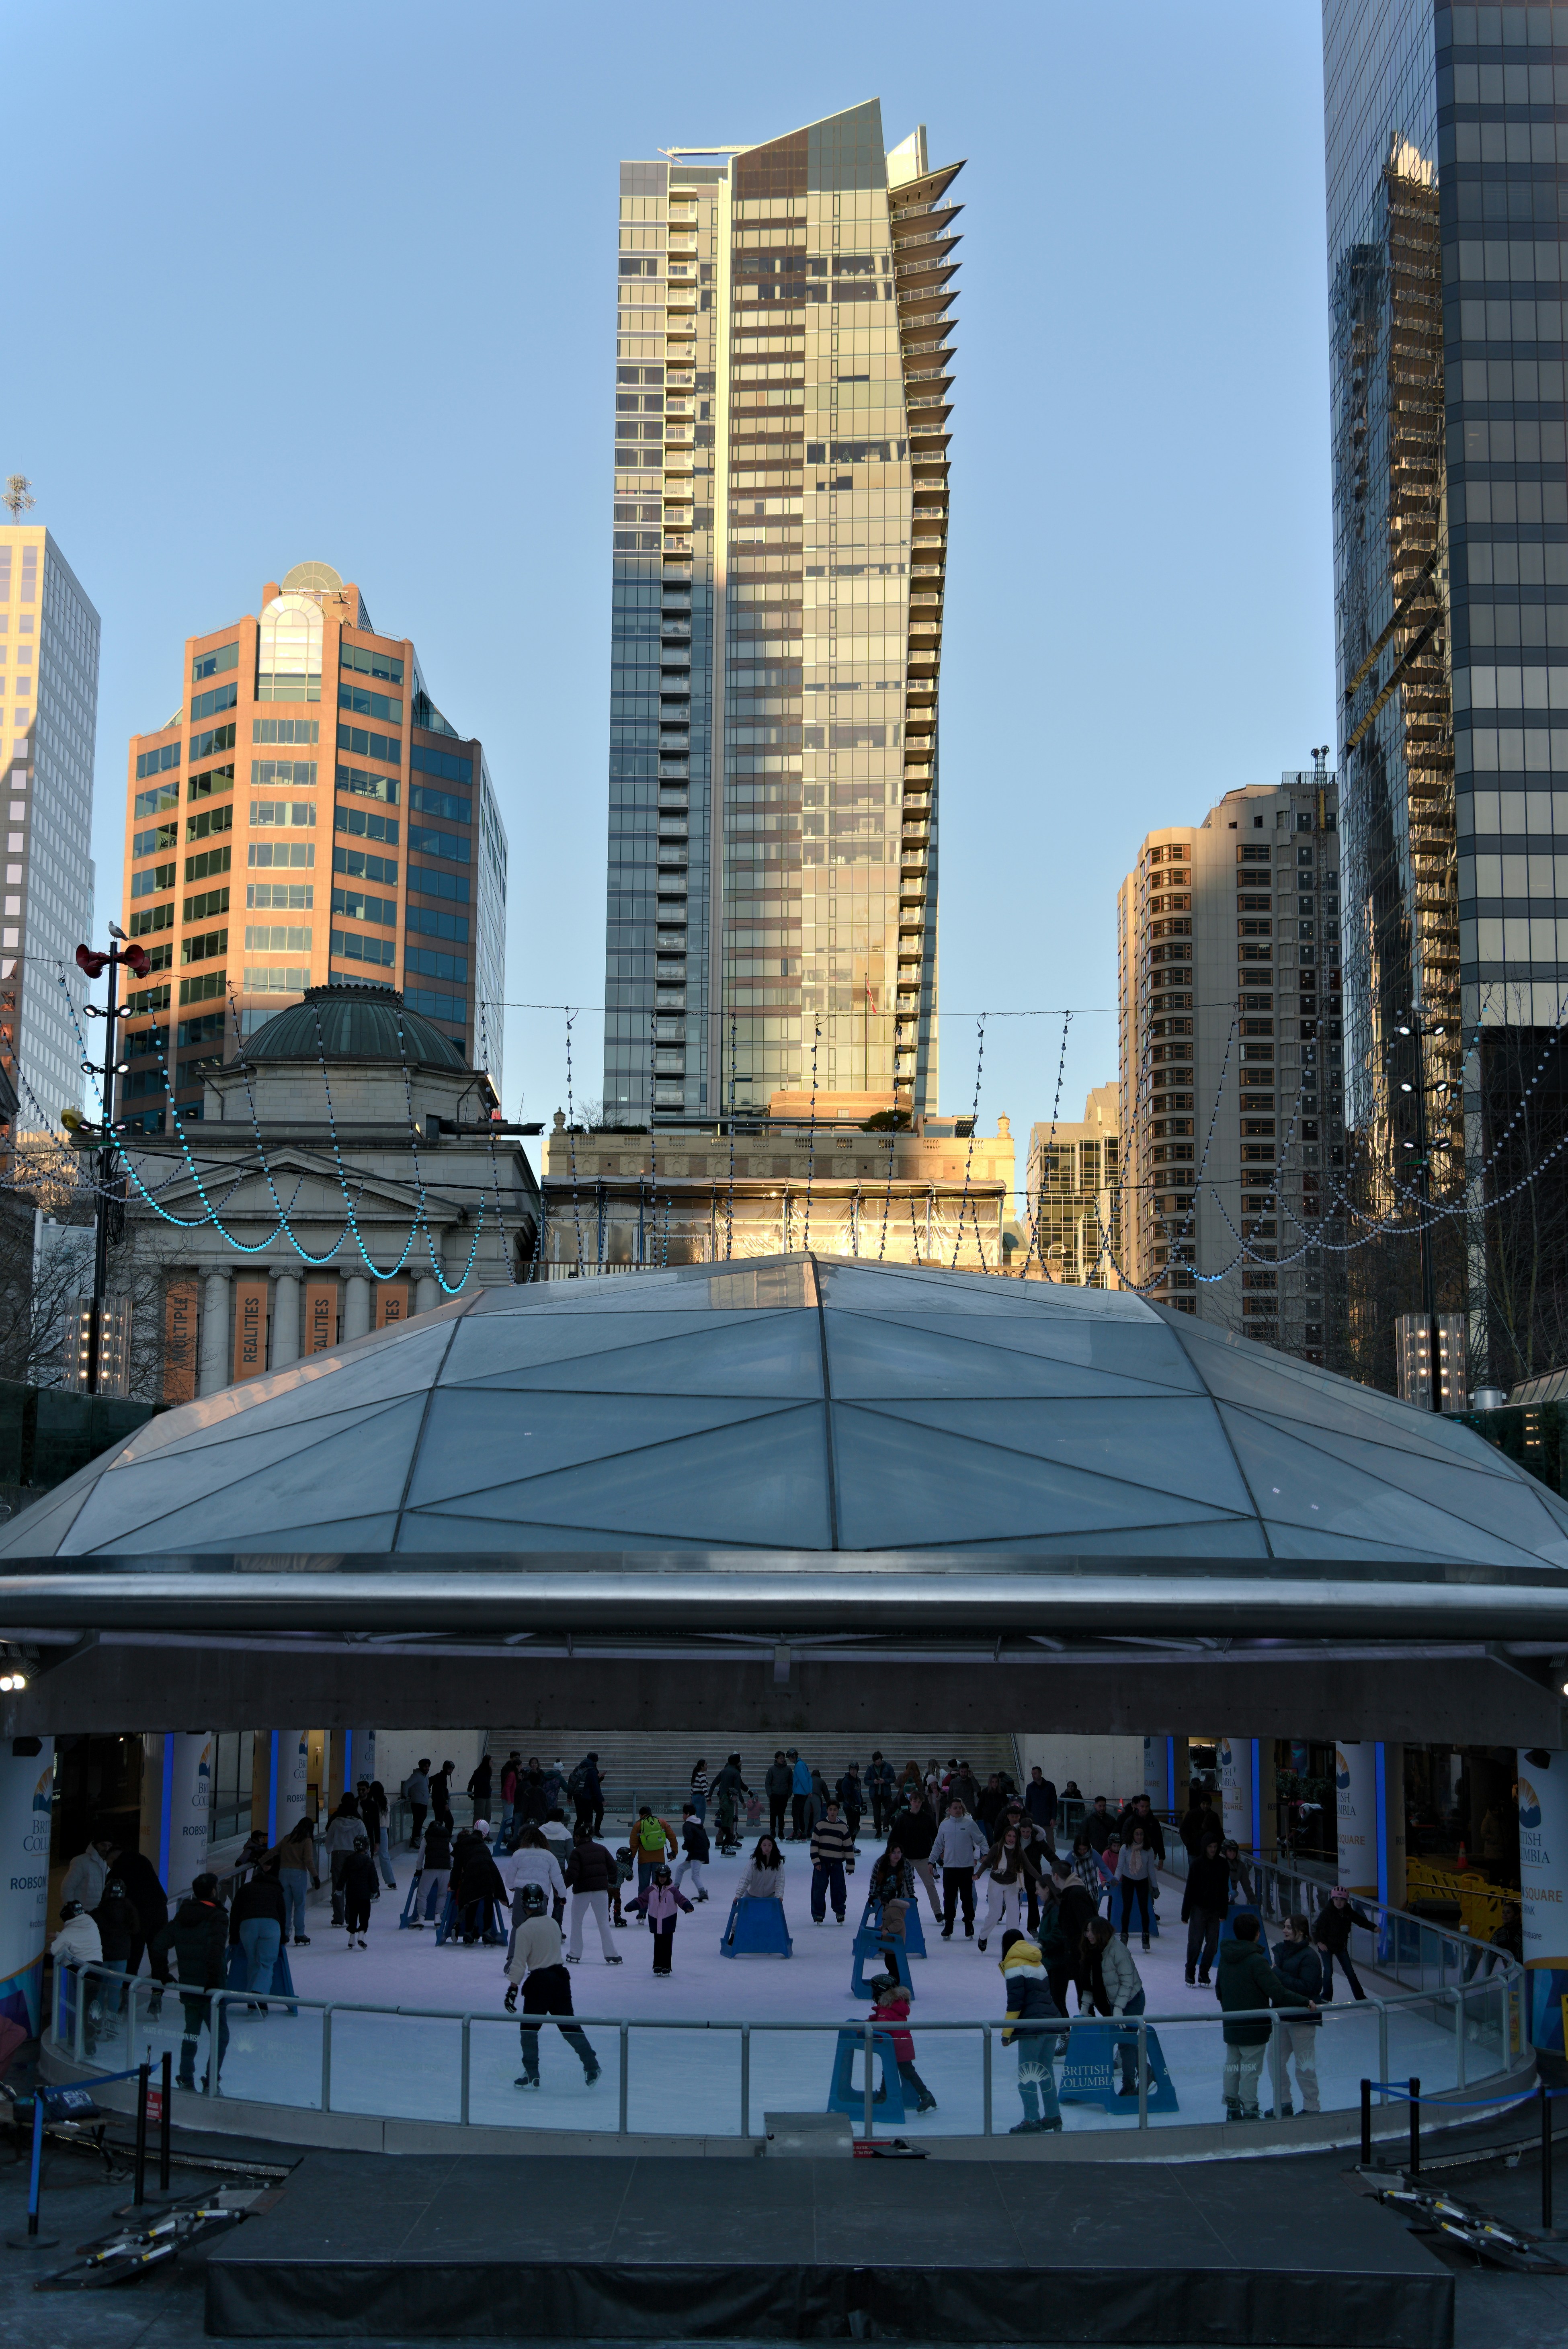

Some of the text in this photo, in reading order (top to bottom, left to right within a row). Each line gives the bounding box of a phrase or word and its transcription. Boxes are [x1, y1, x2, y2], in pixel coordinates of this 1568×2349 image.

[172, 1297, 188, 1362] MULTIPLE
[243, 1298, 259, 1363] REALITIES
[24, 1835, 50, 1851] COLU
[1338, 1834, 1365, 1845] SQUARE
[10, 1876, 46, 1890] ROBSON
[1525, 1887, 1563, 1903] SQUARE
[190, 2033, 200, 2042] RISK
[1062, 2065, 1109, 2076] BRITISH
[1240, 2063, 1256, 2071] RISK
